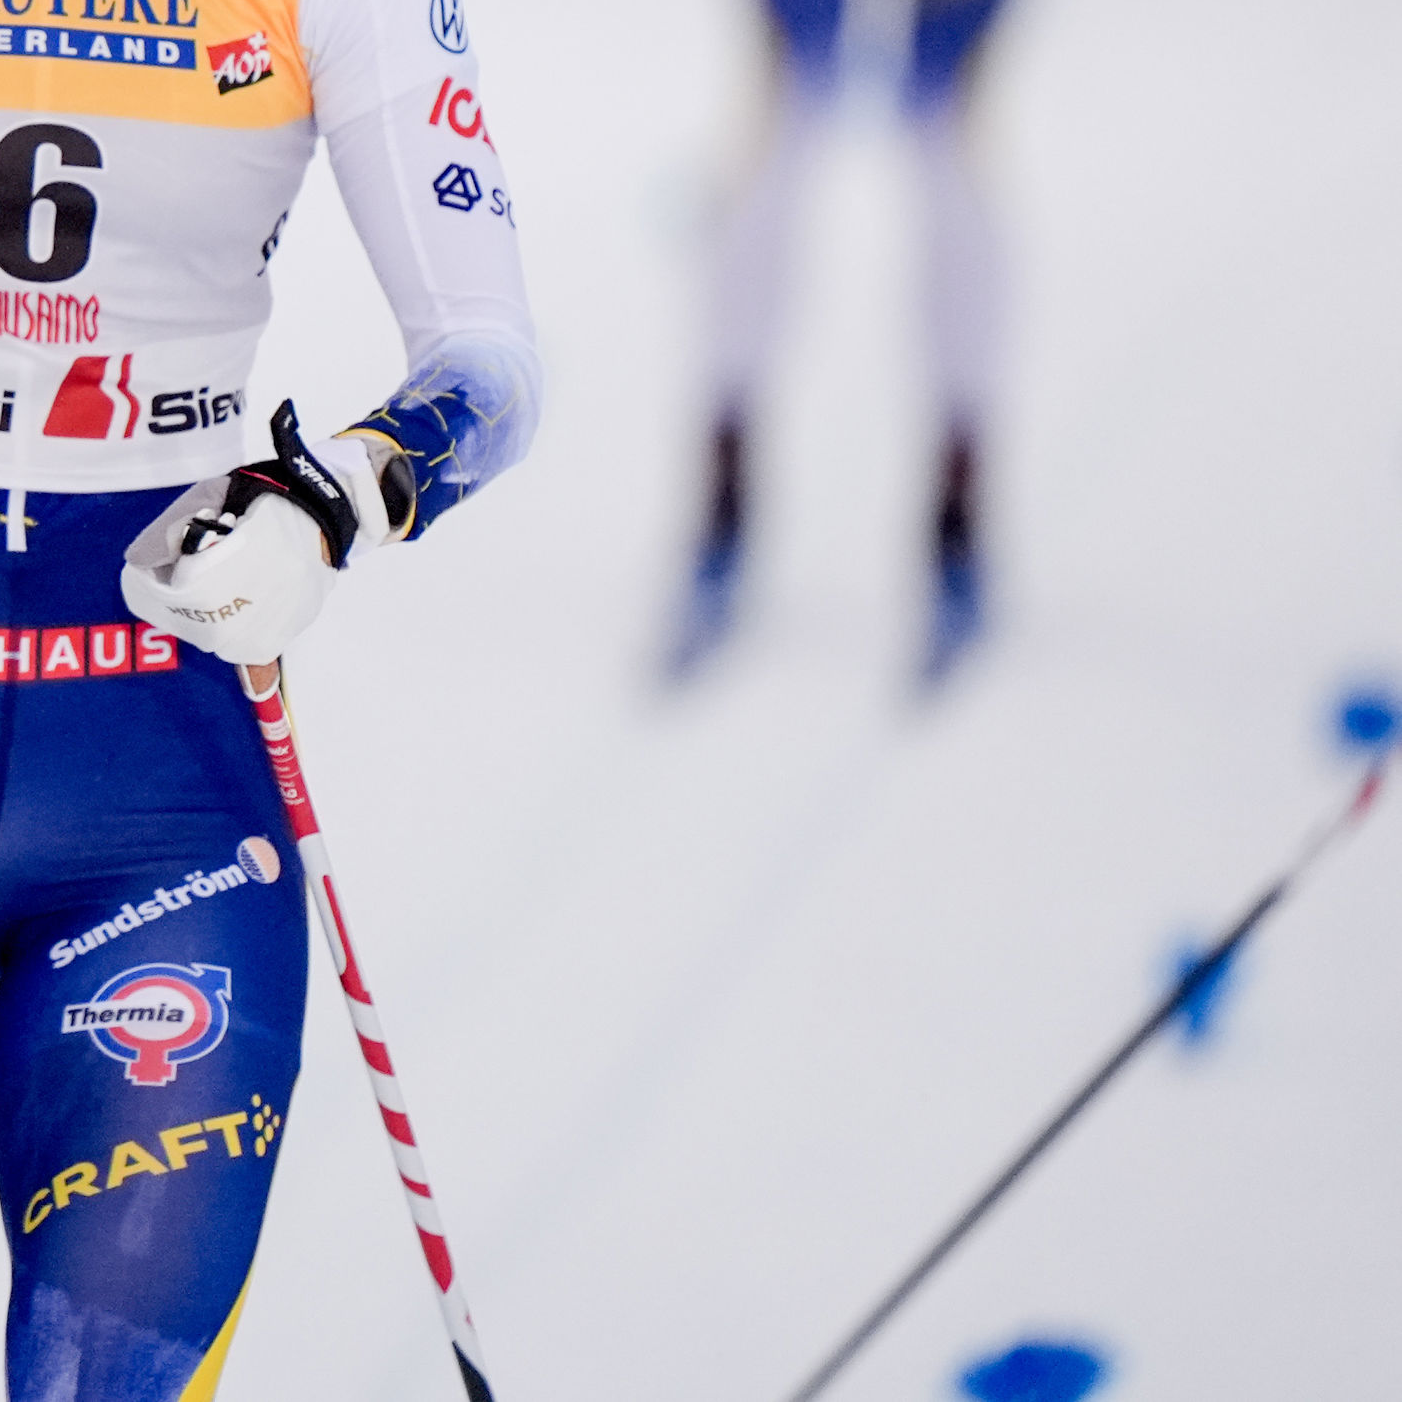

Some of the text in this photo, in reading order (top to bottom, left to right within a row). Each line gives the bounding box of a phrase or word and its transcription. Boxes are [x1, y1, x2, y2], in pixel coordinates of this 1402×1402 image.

[212, 48, 272, 84] AOP
[167, 596, 253, 624] HESTRA
[48, 863, 249, 970] Sundström
[66, 1005, 186, 1028] Thermia
[22, 1110, 249, 1235] CRAFT
